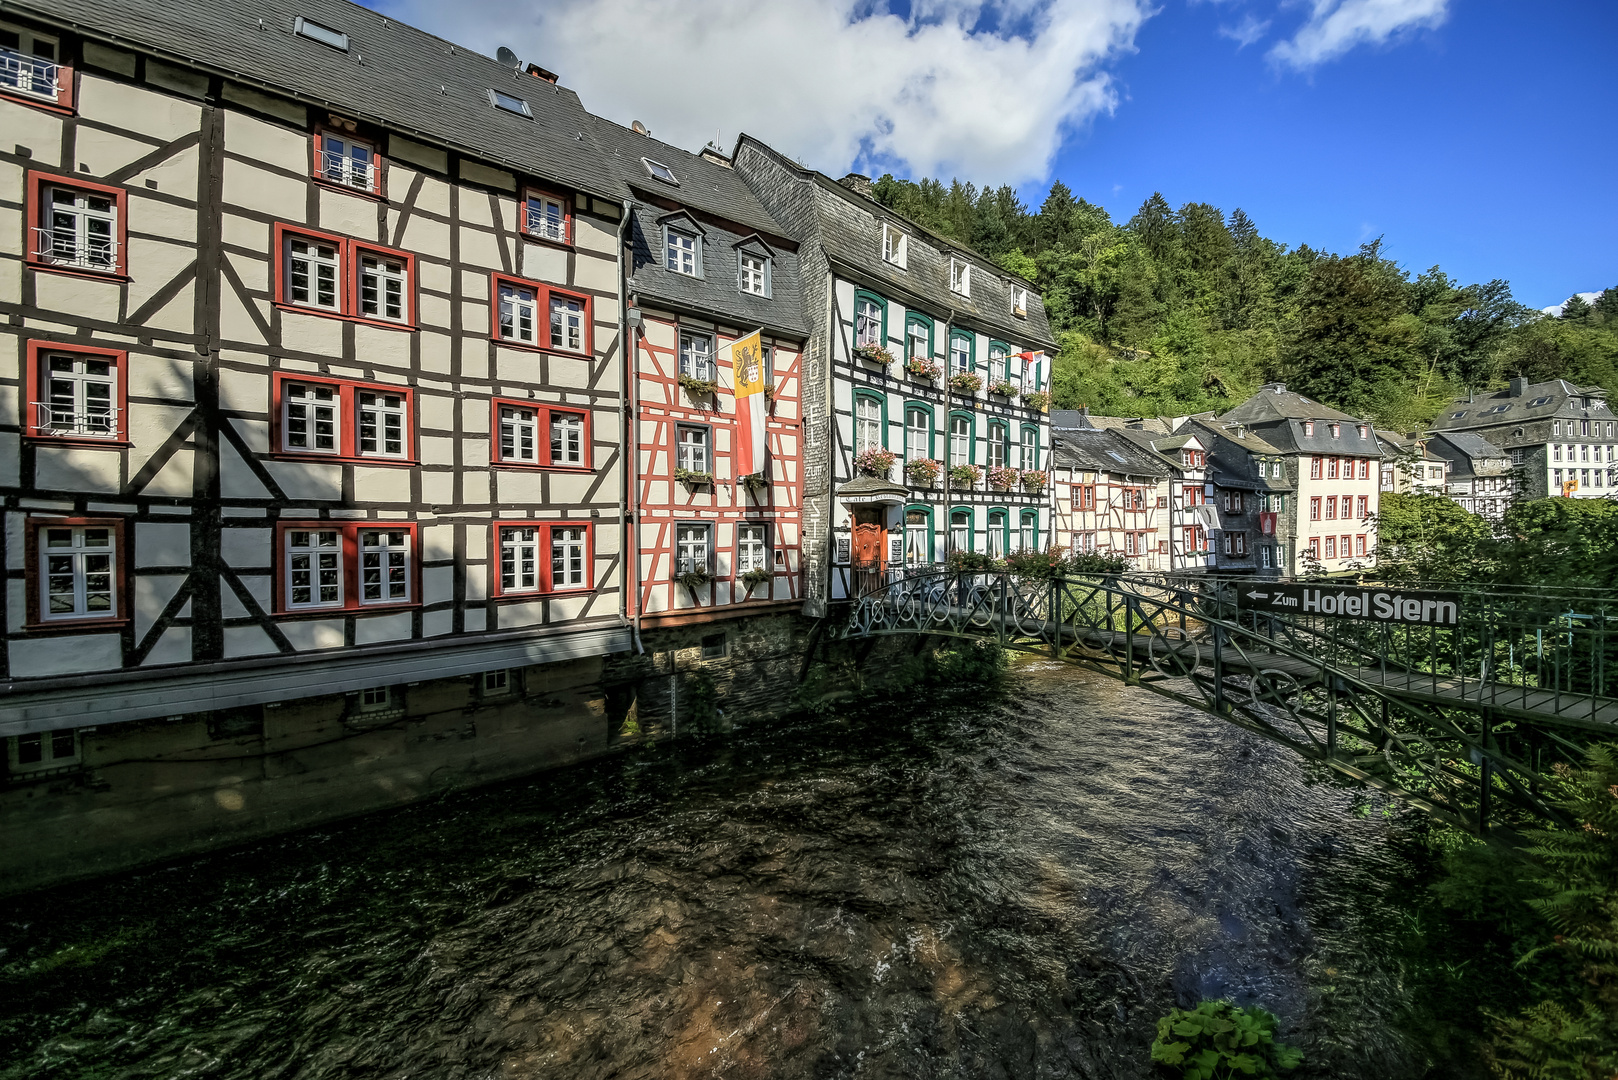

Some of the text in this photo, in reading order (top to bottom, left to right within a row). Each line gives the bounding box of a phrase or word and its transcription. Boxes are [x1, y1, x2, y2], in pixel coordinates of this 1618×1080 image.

[809, 336, 821, 447] HOTEL
[808, 498, 821, 599] STERN
[1272, 589, 1456, 625] Zum Hotel Stern
